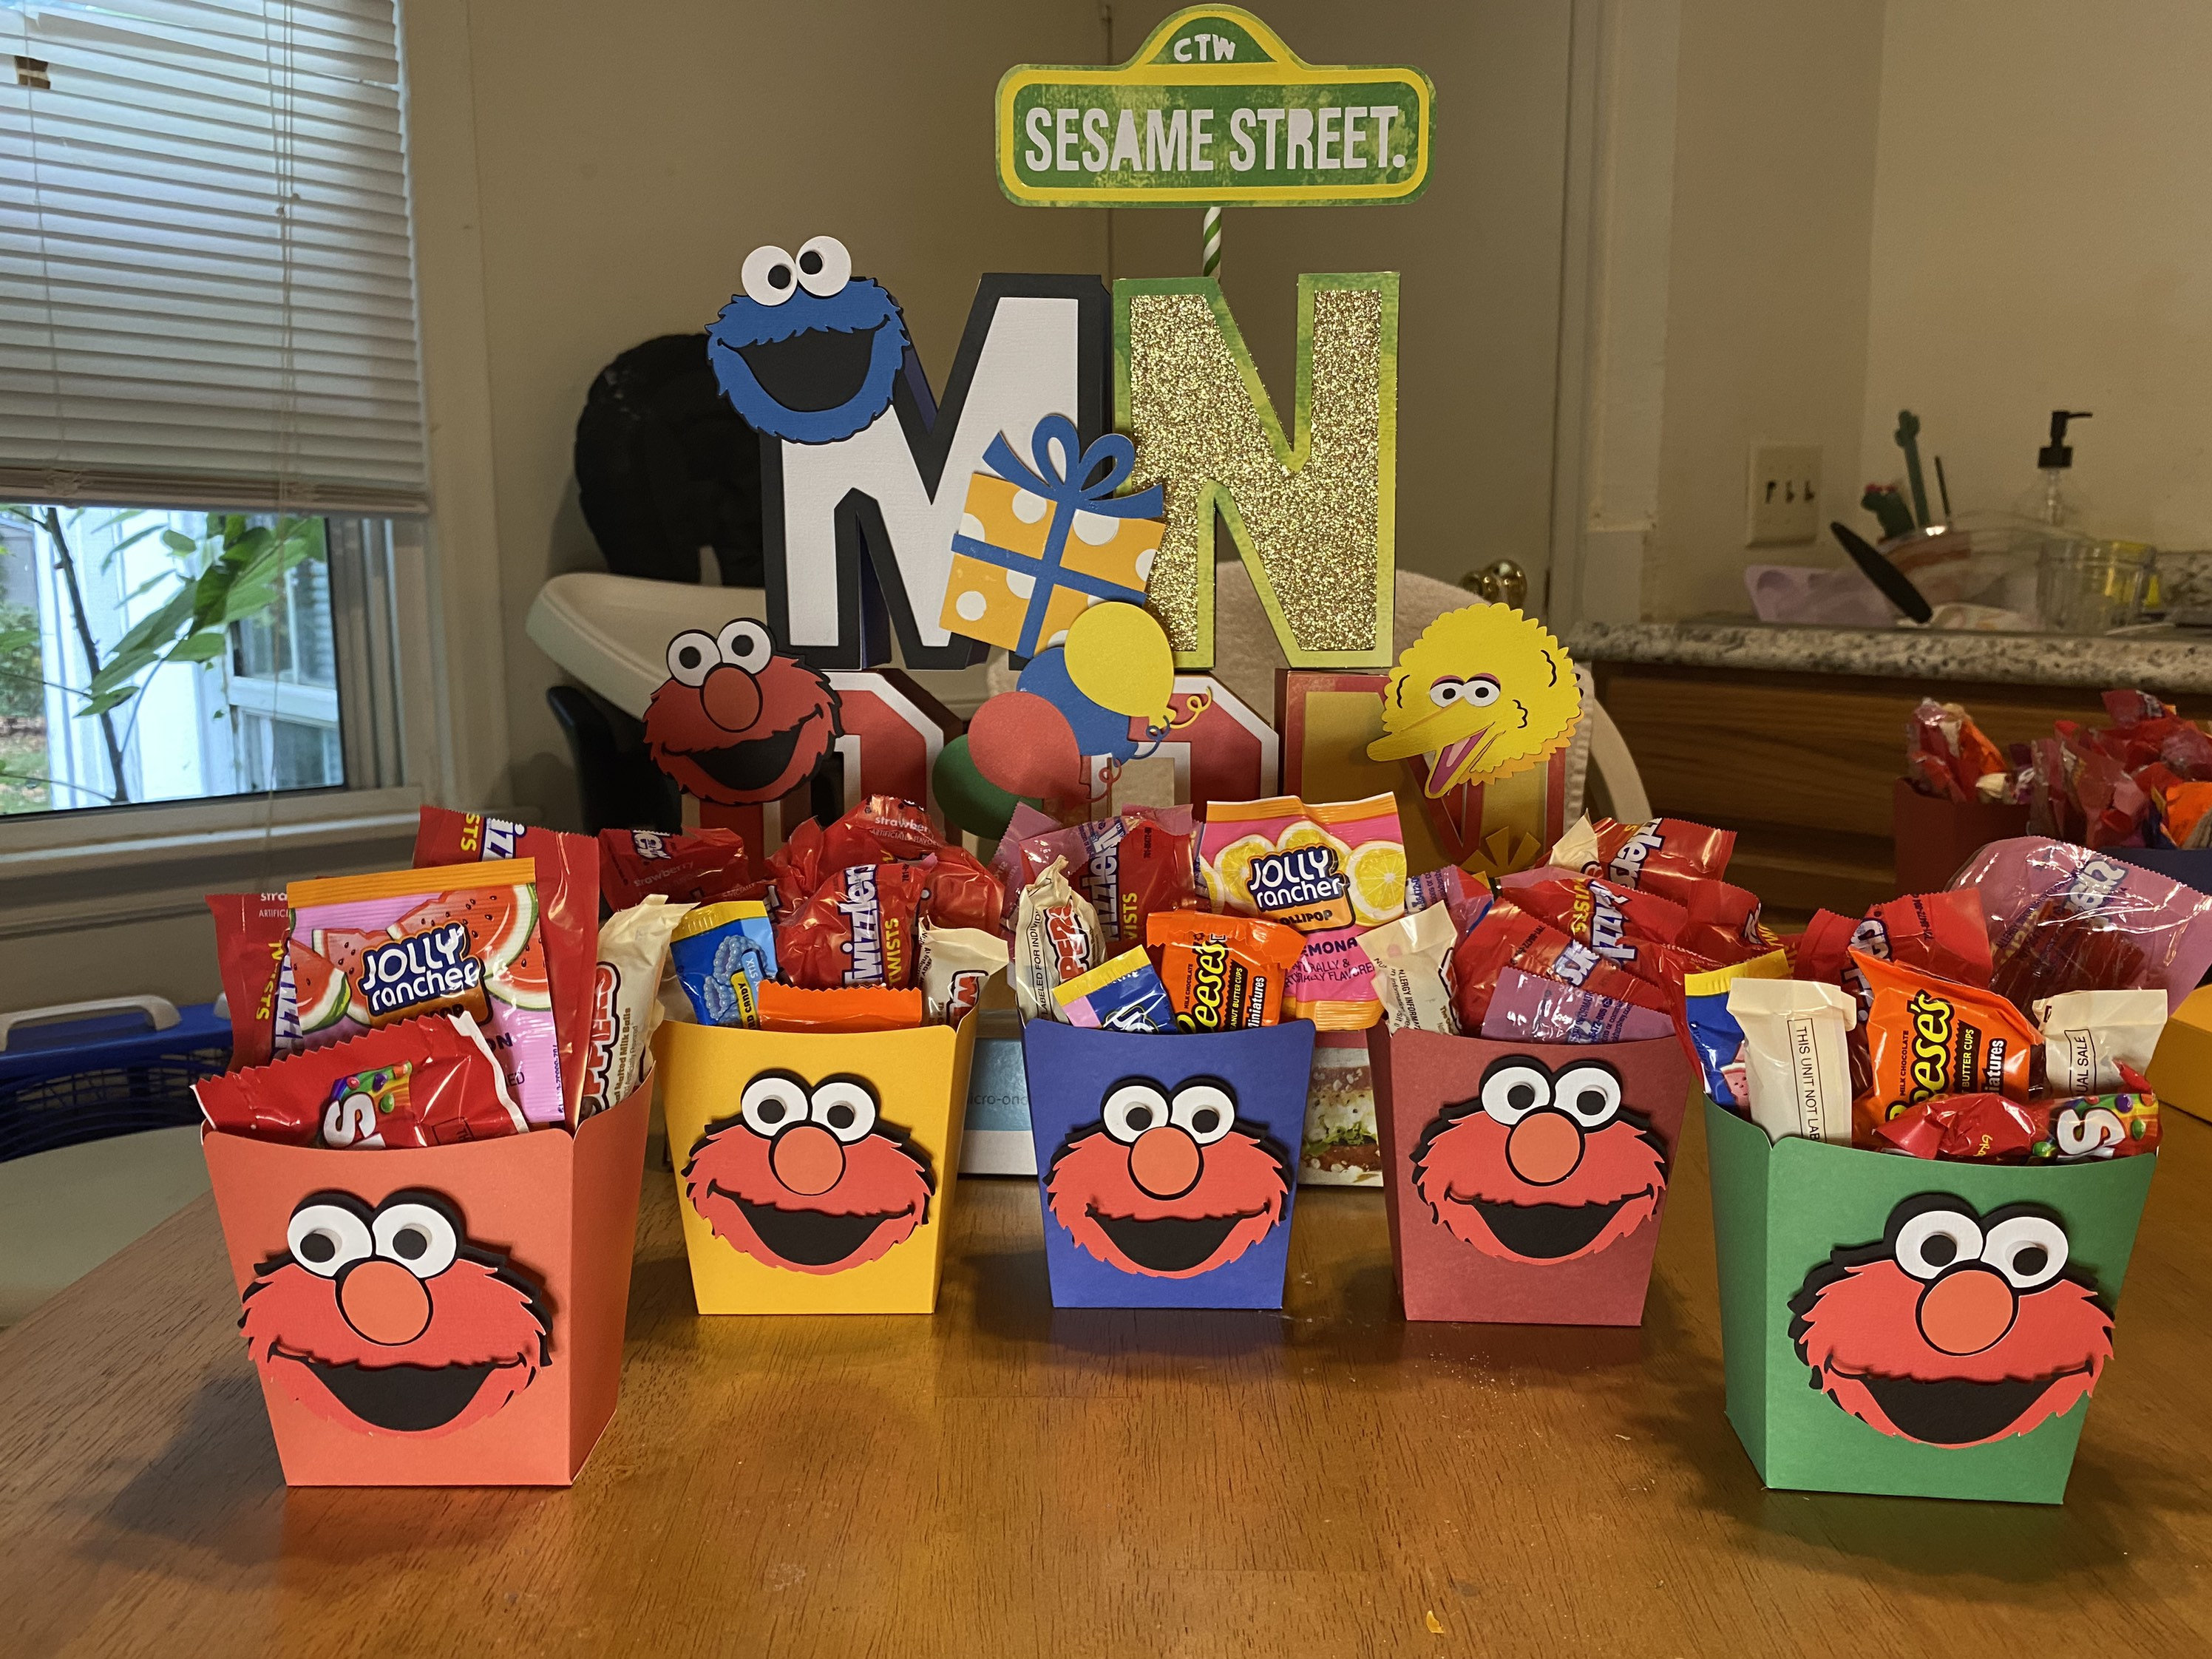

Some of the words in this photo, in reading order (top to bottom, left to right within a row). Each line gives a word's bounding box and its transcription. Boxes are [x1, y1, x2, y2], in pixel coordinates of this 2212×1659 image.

[1174, 34, 1235, 61] CTW
[1025, 108, 1214, 172] SESAME
[1229, 106, 1406, 171] STREET.
[633, 860, 694, 887] strawberry
[1250, 850, 1329, 890] JOLLY
[1257, 878, 1344, 908] rancher
[1279, 909, 1333, 925] OLLIPOP
[363, 927, 465, 991] JOLLY
[746, 957, 759, 979] STIX
[1033, 949, 1042, 970] FOR
[1342, 959, 1351, 967] &
[372, 963, 480, 1011] rancher
[1036, 972, 1048, 1016] LABELED
[1232, 983, 1241, 1008] BUTTER
[622, 1008, 631, 1033] Balls
[1230, 1008, 1238, 1031] EANUT
[620, 1034, 628, 1056] Milk
[1796, 1026, 1811, 1054] THIS
[1964, 1028, 1975, 1050] CUPS
[2074, 1036, 2090, 1067] SALE
[1901, 1031, 1909, 1076] CHOCOLATE
[1984, 1039, 2004, 1095] iatures
[1801, 1058, 1814, 1086] UNIT
[1962, 1053, 1972, 1088] BUTTER
[2076, 1069, 2090, 1096] UAL
[1805, 1089, 1817, 1115] NOT
